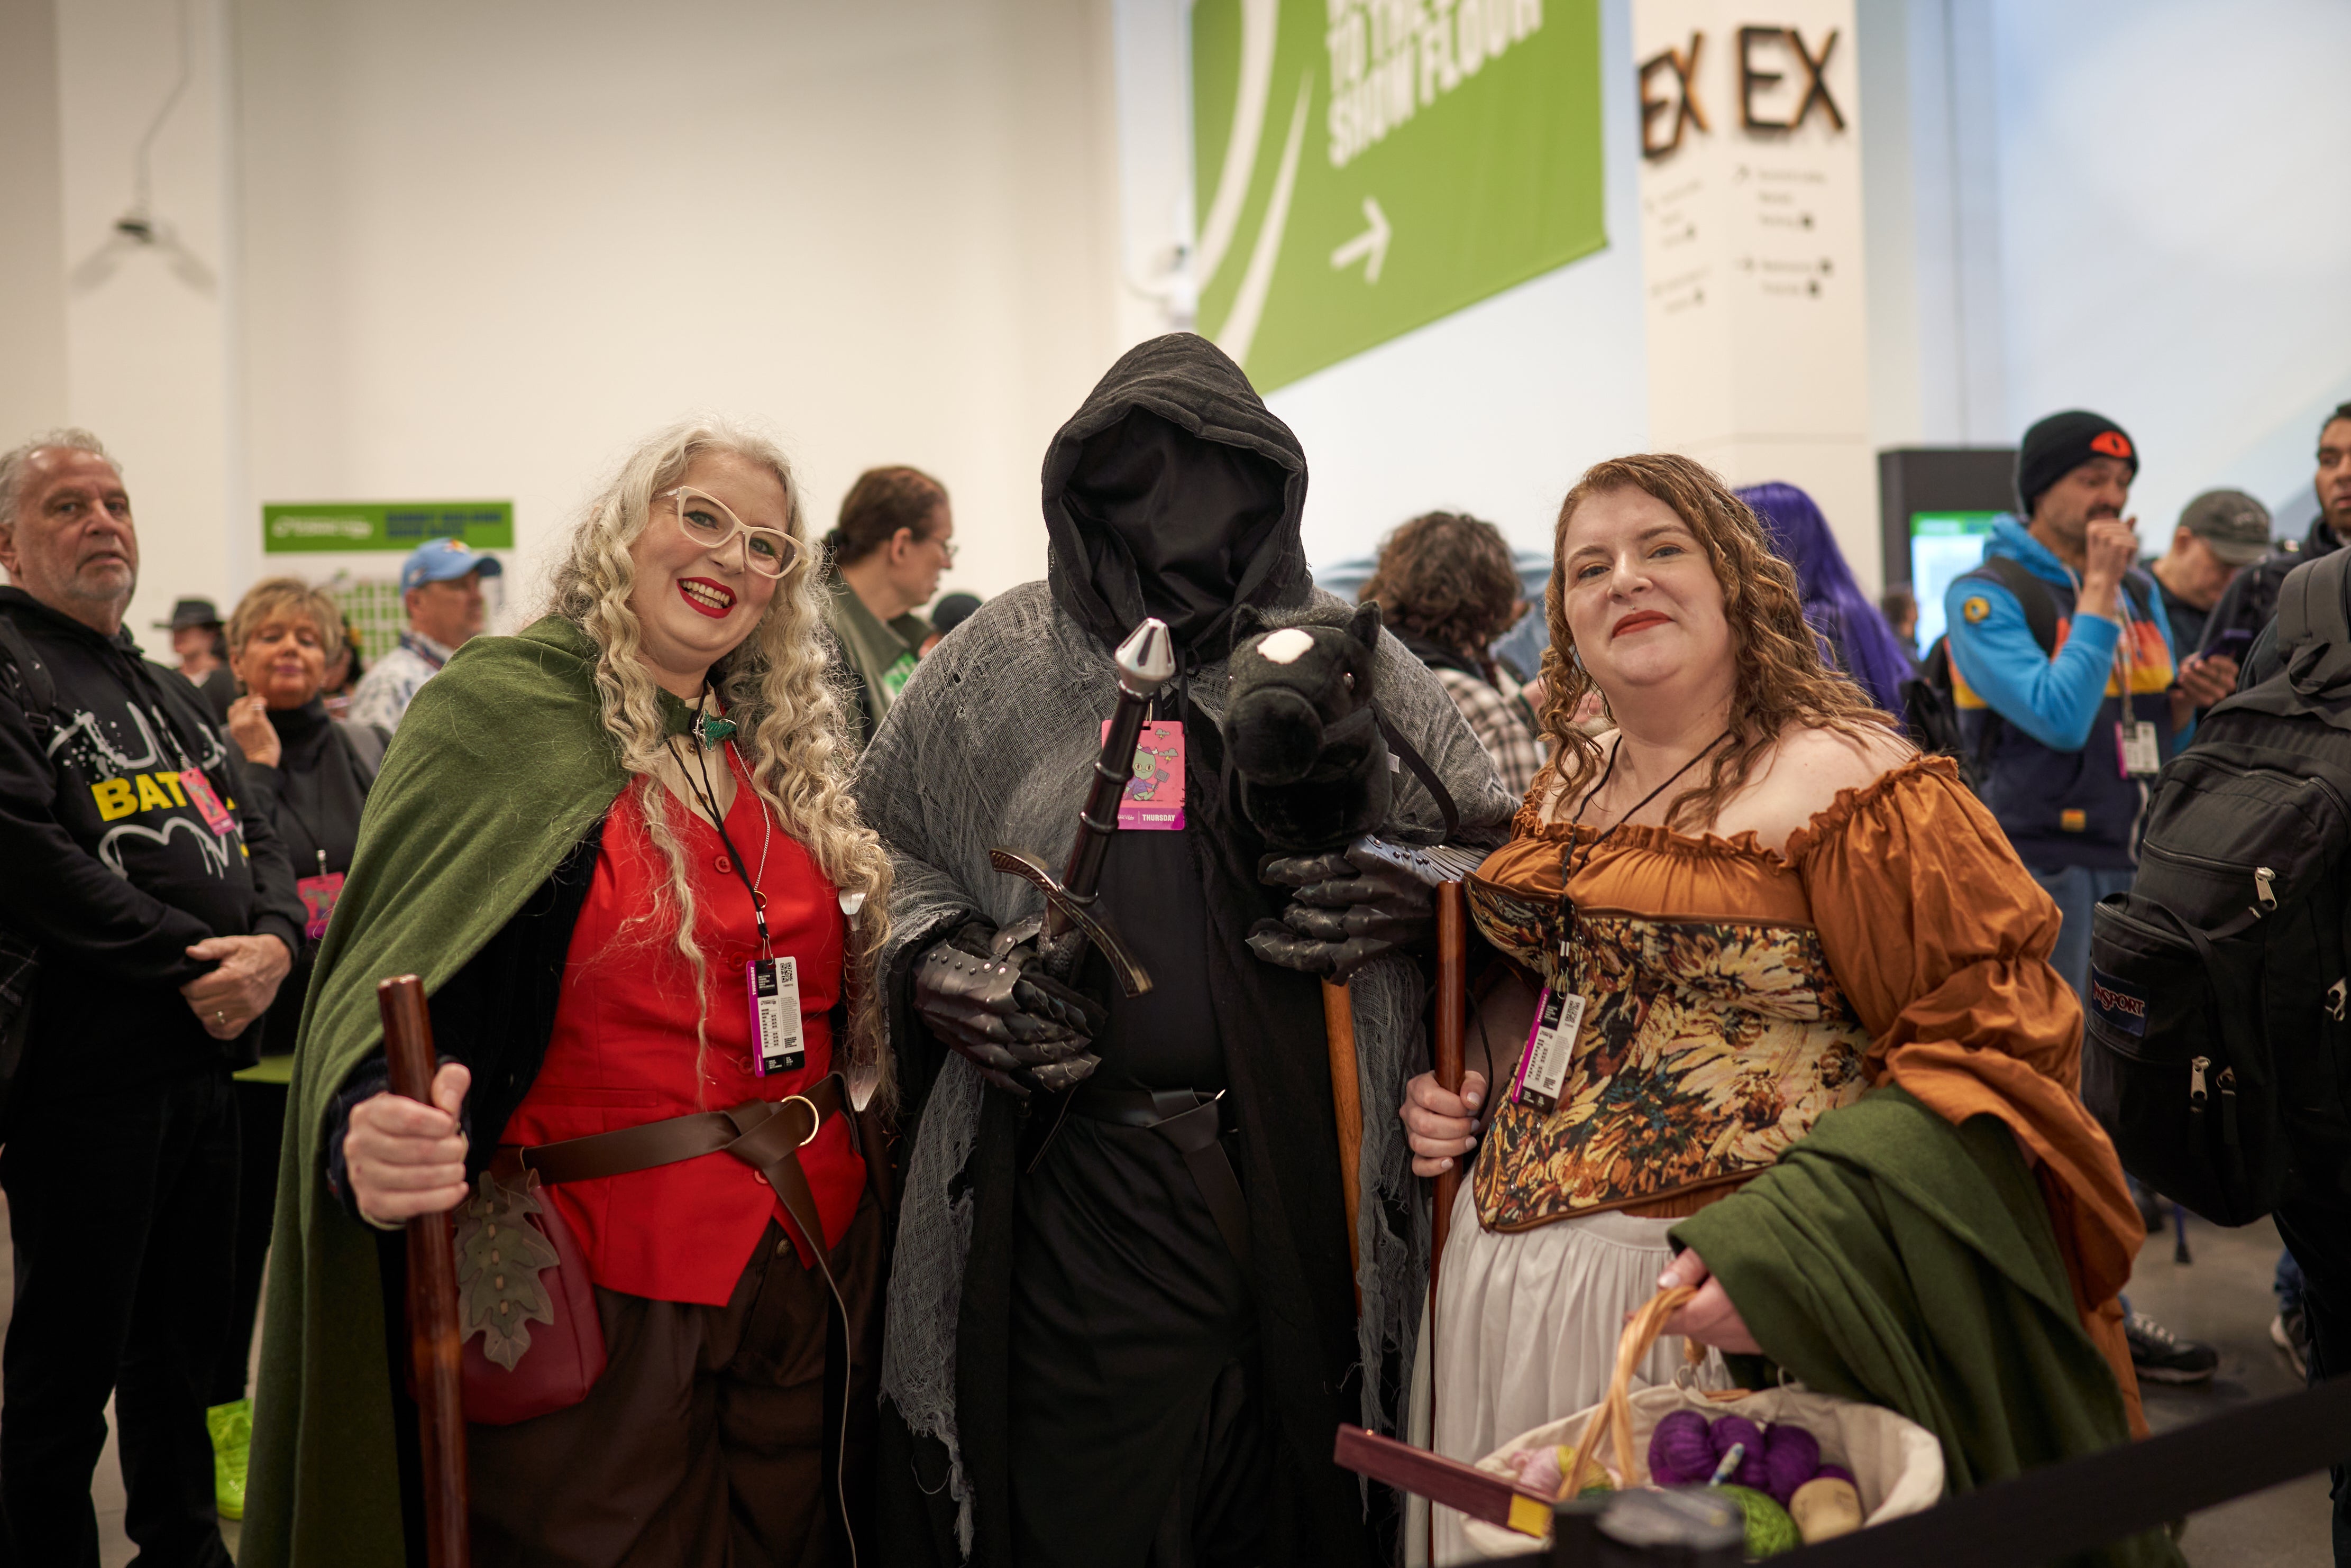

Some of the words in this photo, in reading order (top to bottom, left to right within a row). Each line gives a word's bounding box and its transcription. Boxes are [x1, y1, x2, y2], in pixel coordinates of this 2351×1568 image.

[1328, 45, 1416, 169] SHOW
[1636, 29, 1709, 160] EX
[1737, 22, 1847, 133] EX
[1537, 993, 1548, 1022] THURSDAY
[2093, 979, 2145, 1018] ANSPORT
